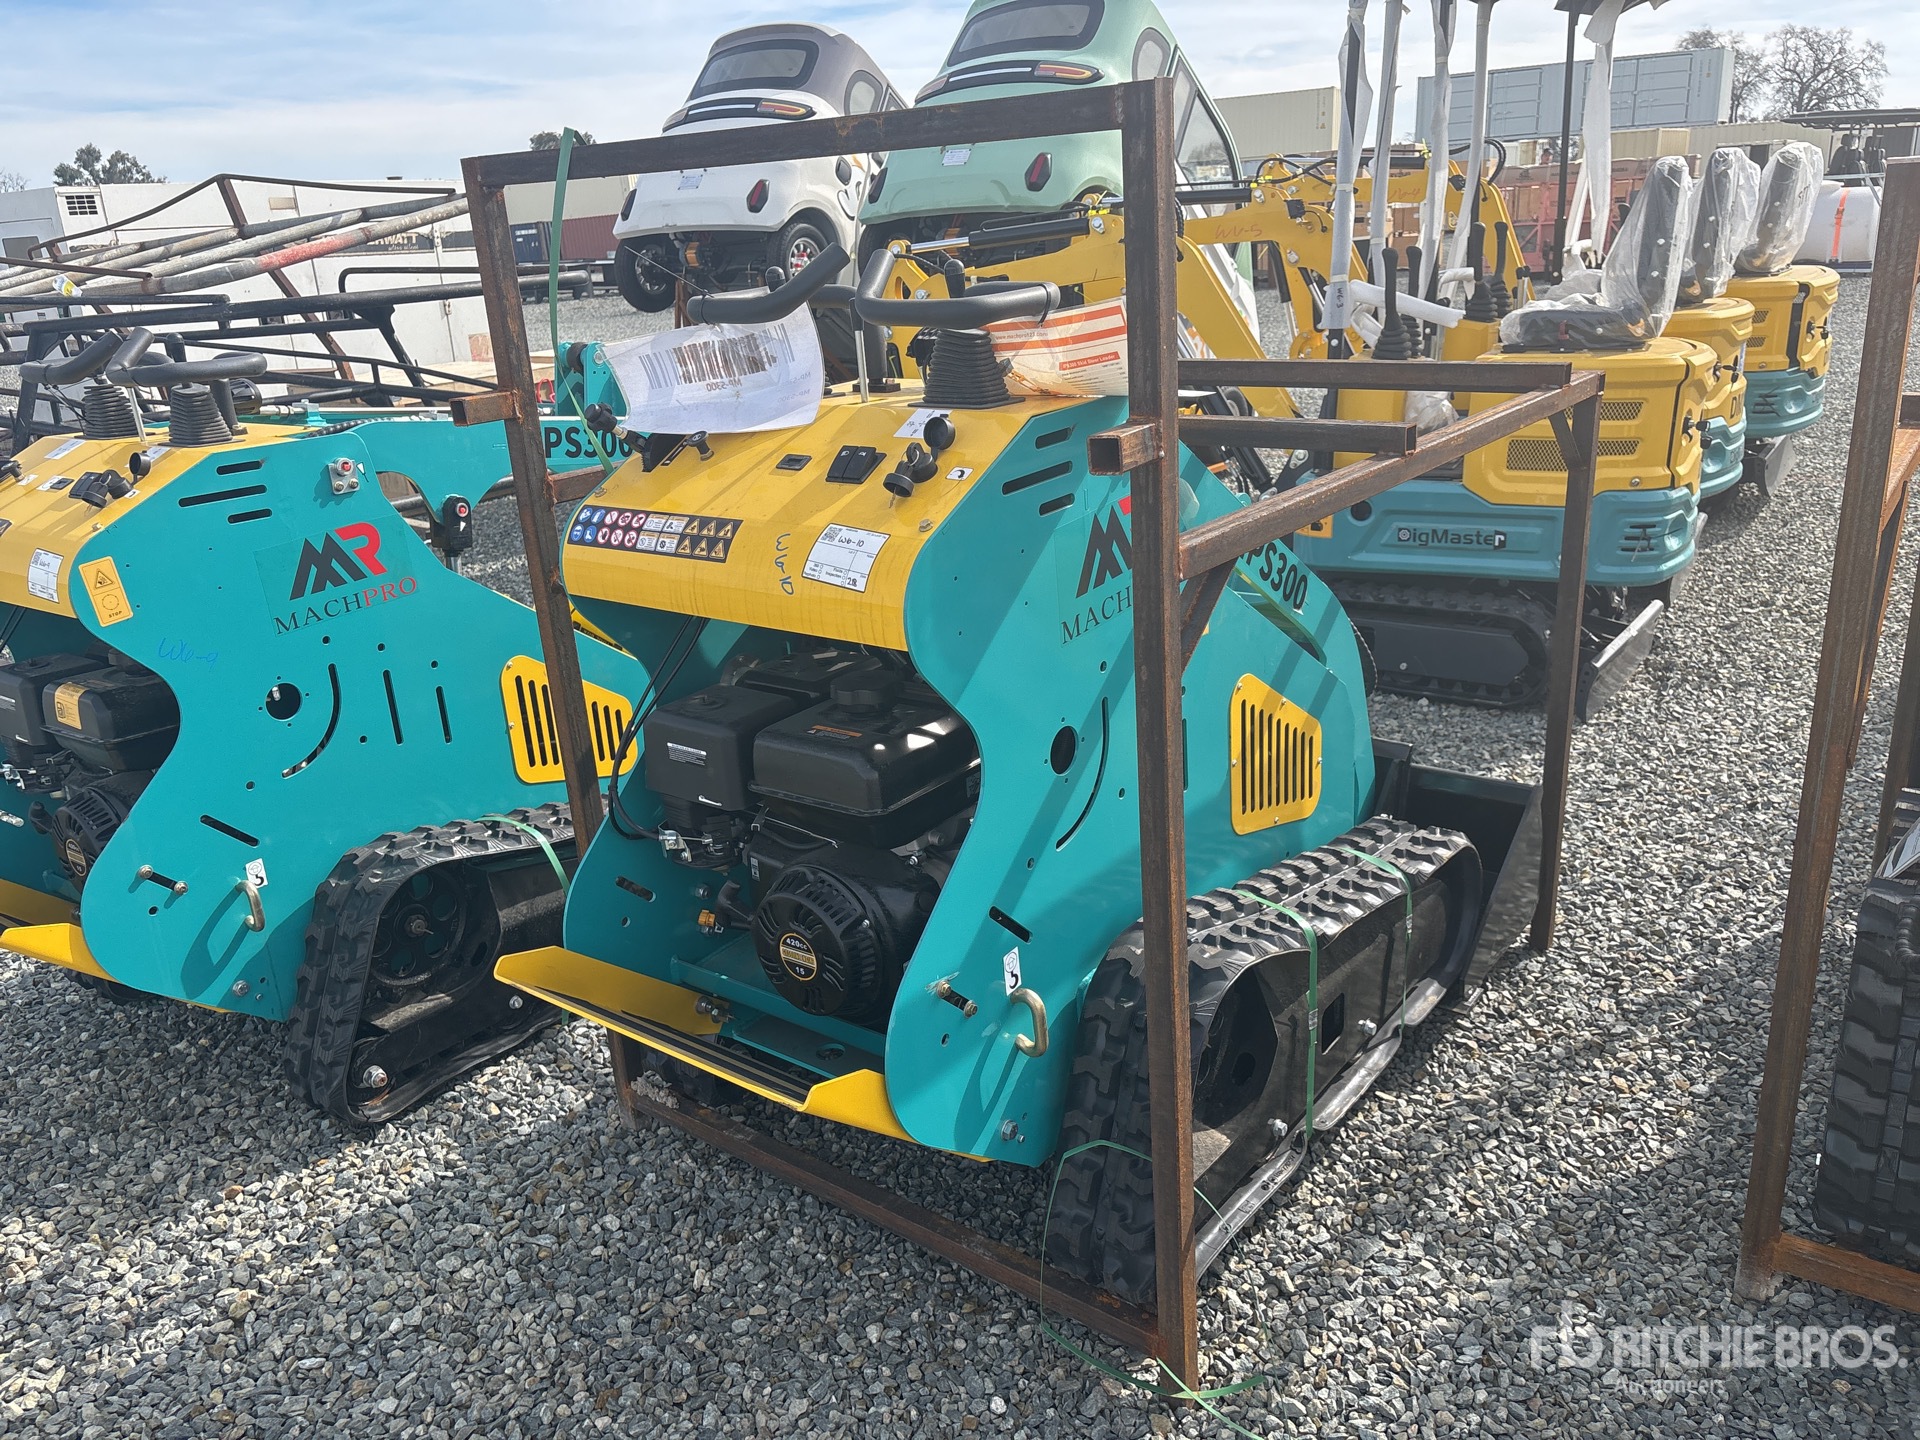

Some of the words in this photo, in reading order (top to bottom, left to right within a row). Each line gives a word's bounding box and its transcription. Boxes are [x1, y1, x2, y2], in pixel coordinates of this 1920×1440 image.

[1397, 527, 1507, 550] DigMaster
[274, 577, 417, 634] MACHPRO
[108, 610, 123, 619] STOP
[786, 937, 808, 950] 420cc
[795, 966, 805, 975] 15
